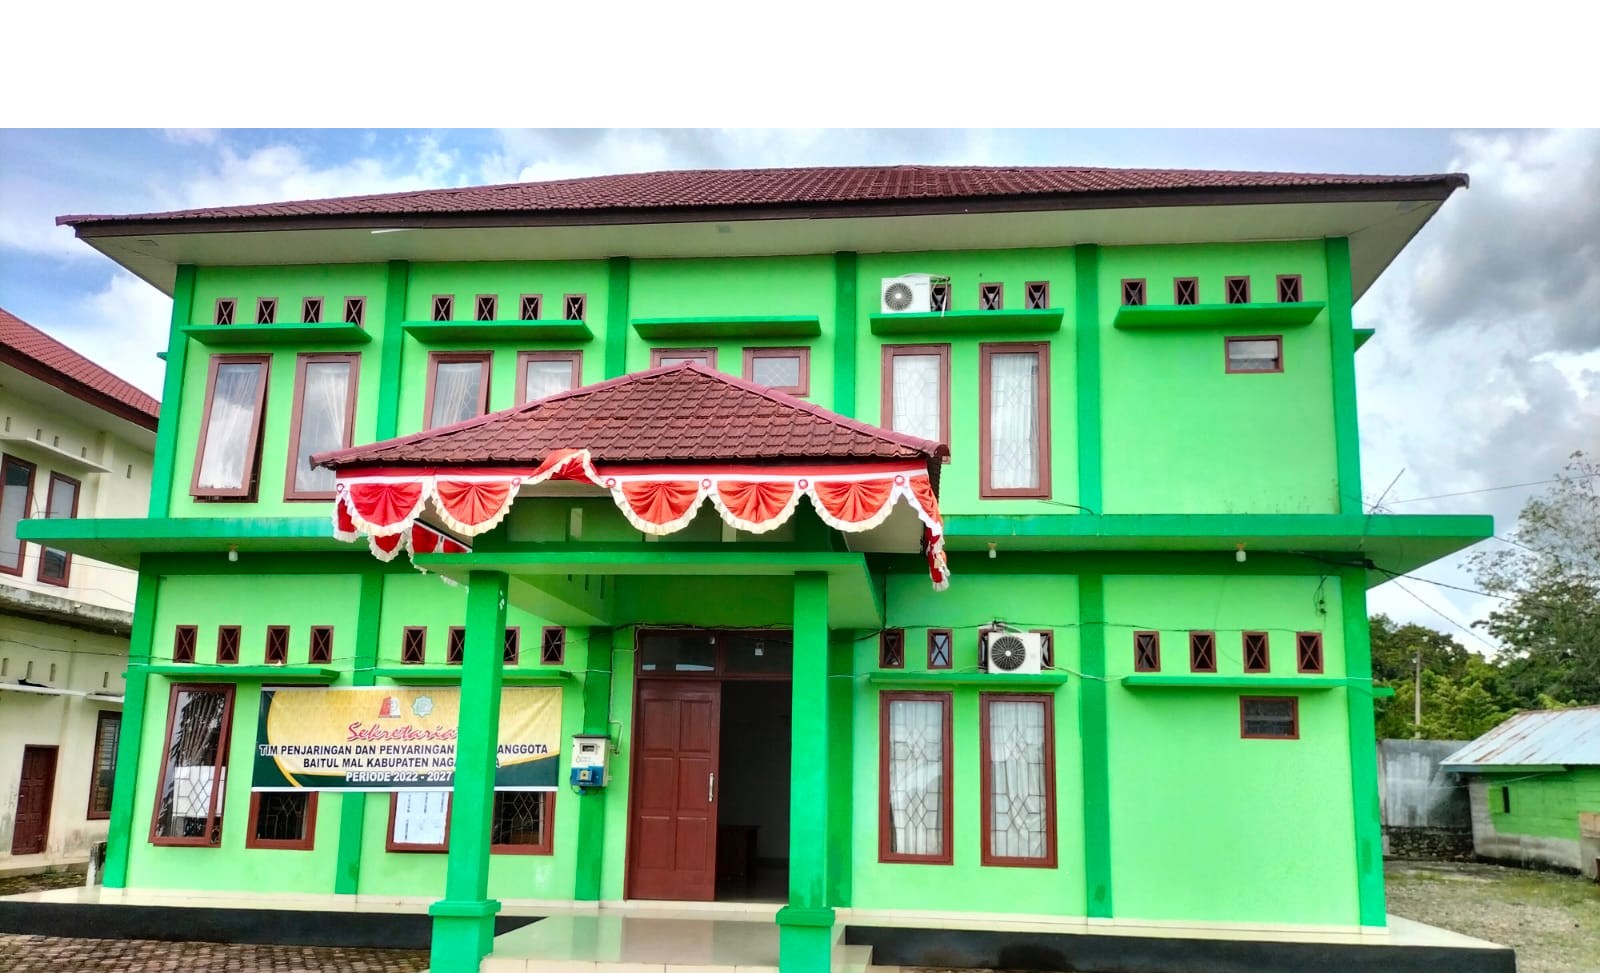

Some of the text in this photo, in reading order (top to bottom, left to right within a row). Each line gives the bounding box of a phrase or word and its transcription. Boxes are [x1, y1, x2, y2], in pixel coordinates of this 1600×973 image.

[347, 721, 459, 741] Sekretaria
[259, 744, 548, 756] TIM PENJARINGAN DAN PENYARINGAN ANGGOTA
[303, 758, 456, 768] BAITUL MAL KABUPATEN NAG
[345, 771, 391, 782] PERIODE
[392, 771, 418, 782] 2022
[426, 771, 452, 782] 2027
